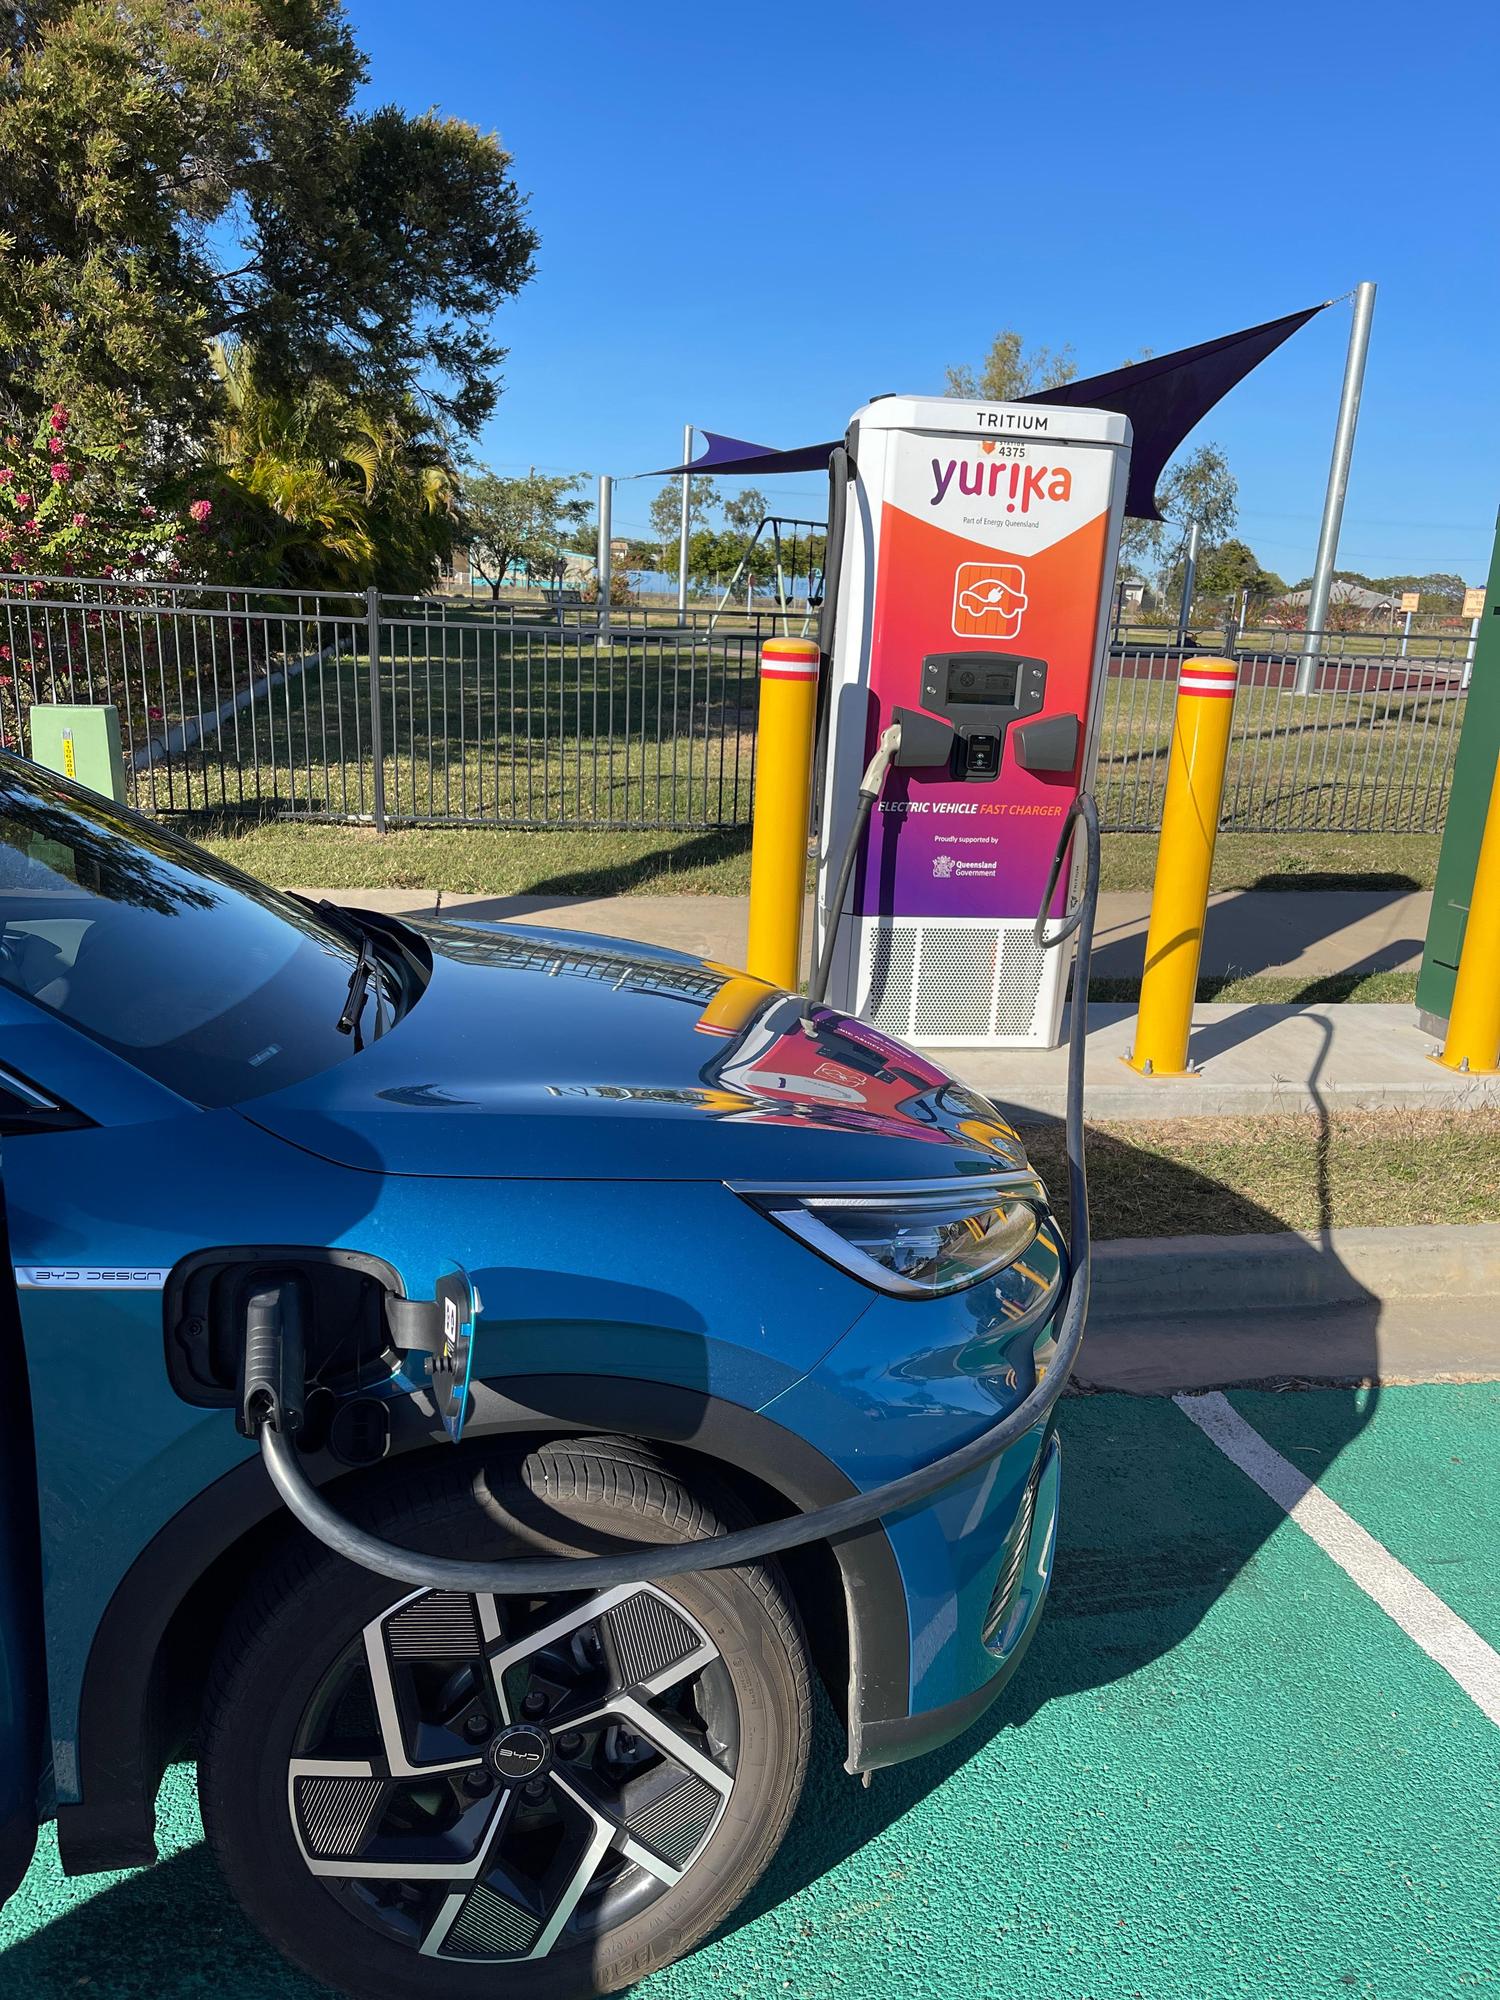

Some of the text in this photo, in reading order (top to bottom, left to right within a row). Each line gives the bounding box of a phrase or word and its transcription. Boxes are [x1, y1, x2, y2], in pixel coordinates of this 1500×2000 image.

[976, 411, 1049, 431] TRITIUM
[998, 446, 1026, 458] 4375
[963, 516, 1040, 529] Part of Energy Queensland
[878, 801, 1063, 817] ELECTRIC VEHICLE FAST CHARGER
[934, 835, 999, 845] Proudly supported by
[956, 860, 998, 870] Queensland
[955, 869, 996, 878] Government
[36, 1271, 162, 1281] BYD DESIGN
[499, 1748, 540, 1761] BYD
